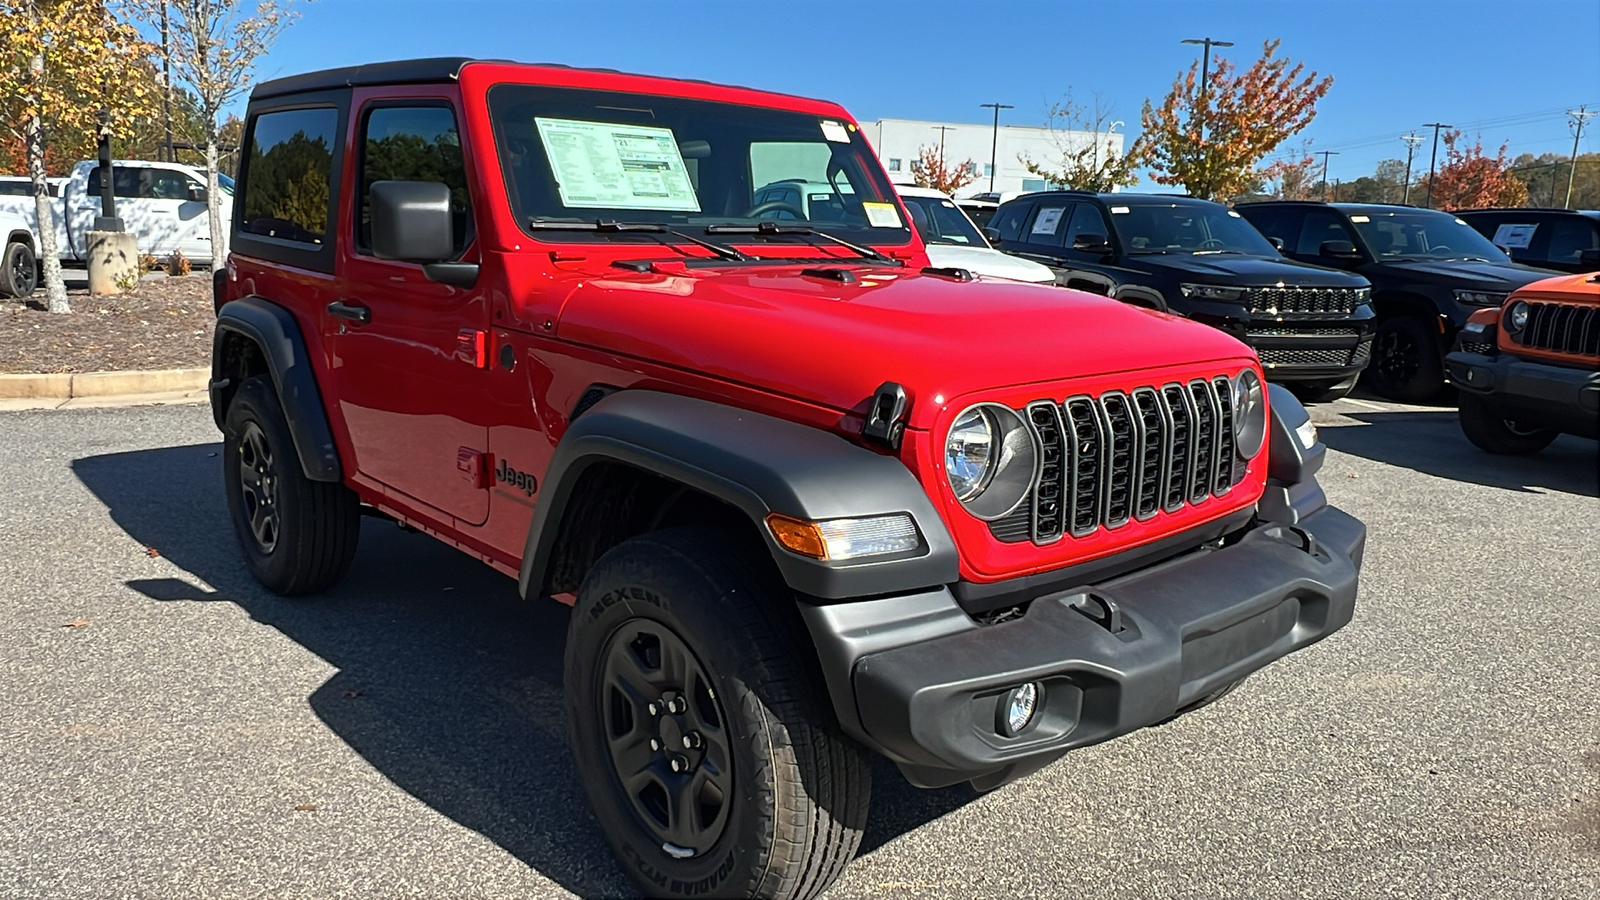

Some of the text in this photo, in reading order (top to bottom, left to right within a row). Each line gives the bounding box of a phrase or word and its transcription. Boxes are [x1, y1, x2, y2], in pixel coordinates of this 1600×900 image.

[495, 458, 537, 498] Jeep
[590, 587, 661, 619] NEXEN
[670, 849, 735, 896] ROADIAN
